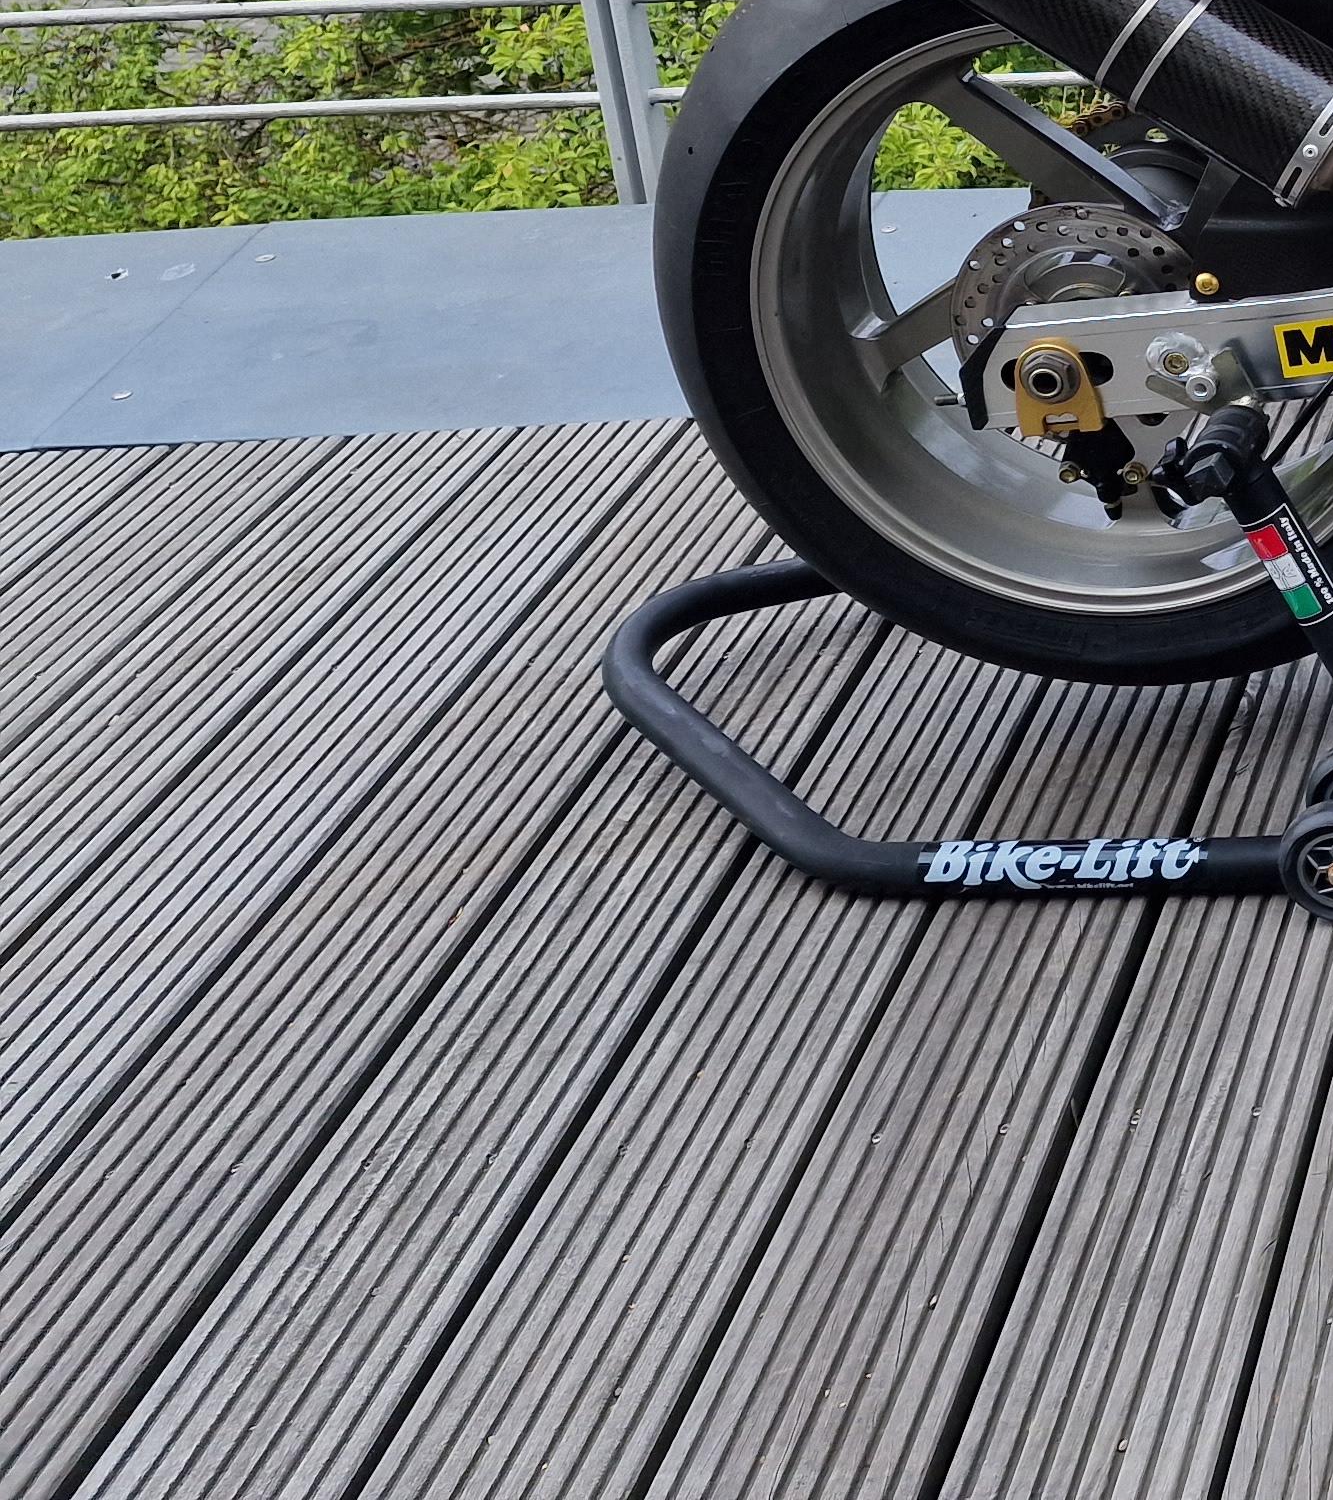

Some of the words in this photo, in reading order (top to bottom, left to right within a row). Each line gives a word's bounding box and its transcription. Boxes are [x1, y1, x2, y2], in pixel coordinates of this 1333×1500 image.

[1279, 516, 1298, 542] Italy
[1300, 551, 1321, 580] Made
[923, 837, 1201, 890] Bike-Lift
